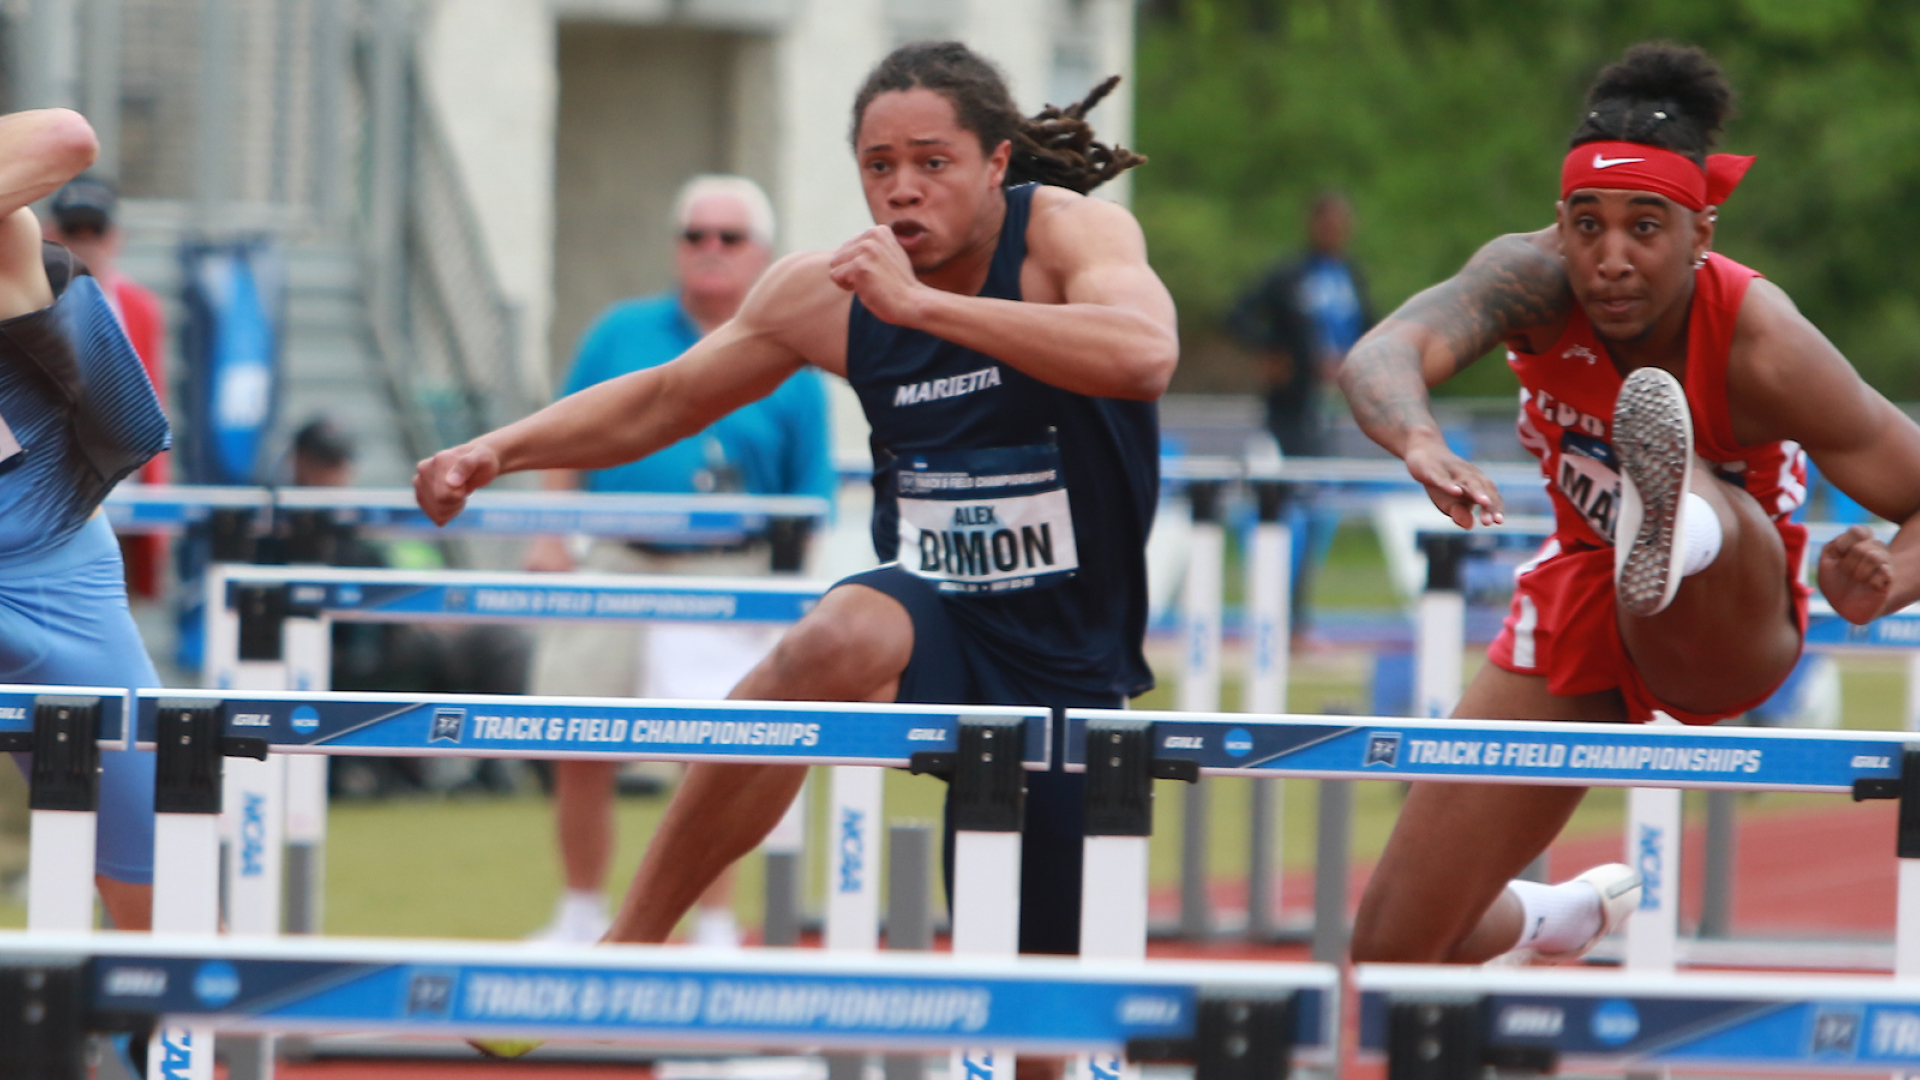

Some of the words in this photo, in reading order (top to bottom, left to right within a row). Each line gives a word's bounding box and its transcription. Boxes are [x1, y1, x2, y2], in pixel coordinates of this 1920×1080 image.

[894, 366, 1002, 407] MARIETTA
[954, 505, 998, 525] ALEX
[919, 522, 1054, 576] DIMON
[231, 713, 271, 727] GILL
[473, 715, 547, 741] TRACK
[546, 717, 565, 741] &
[566, 717, 628, 743] FIELD
[631, 719, 821, 747] CHAMPIONSHIPS
[907, 728, 947, 741] GILL
[1163, 736, 1204, 749] GILL
[1408, 740, 1483, 766] TRACK
[1483, 742, 1502, 766] &
[1502, 743, 1565, 768] FIELD
[1569, 744, 1762, 774] CHAMPIONSHIPS
[1851, 756, 1891, 769] GILL
[241, 791, 266, 877] NCAA
